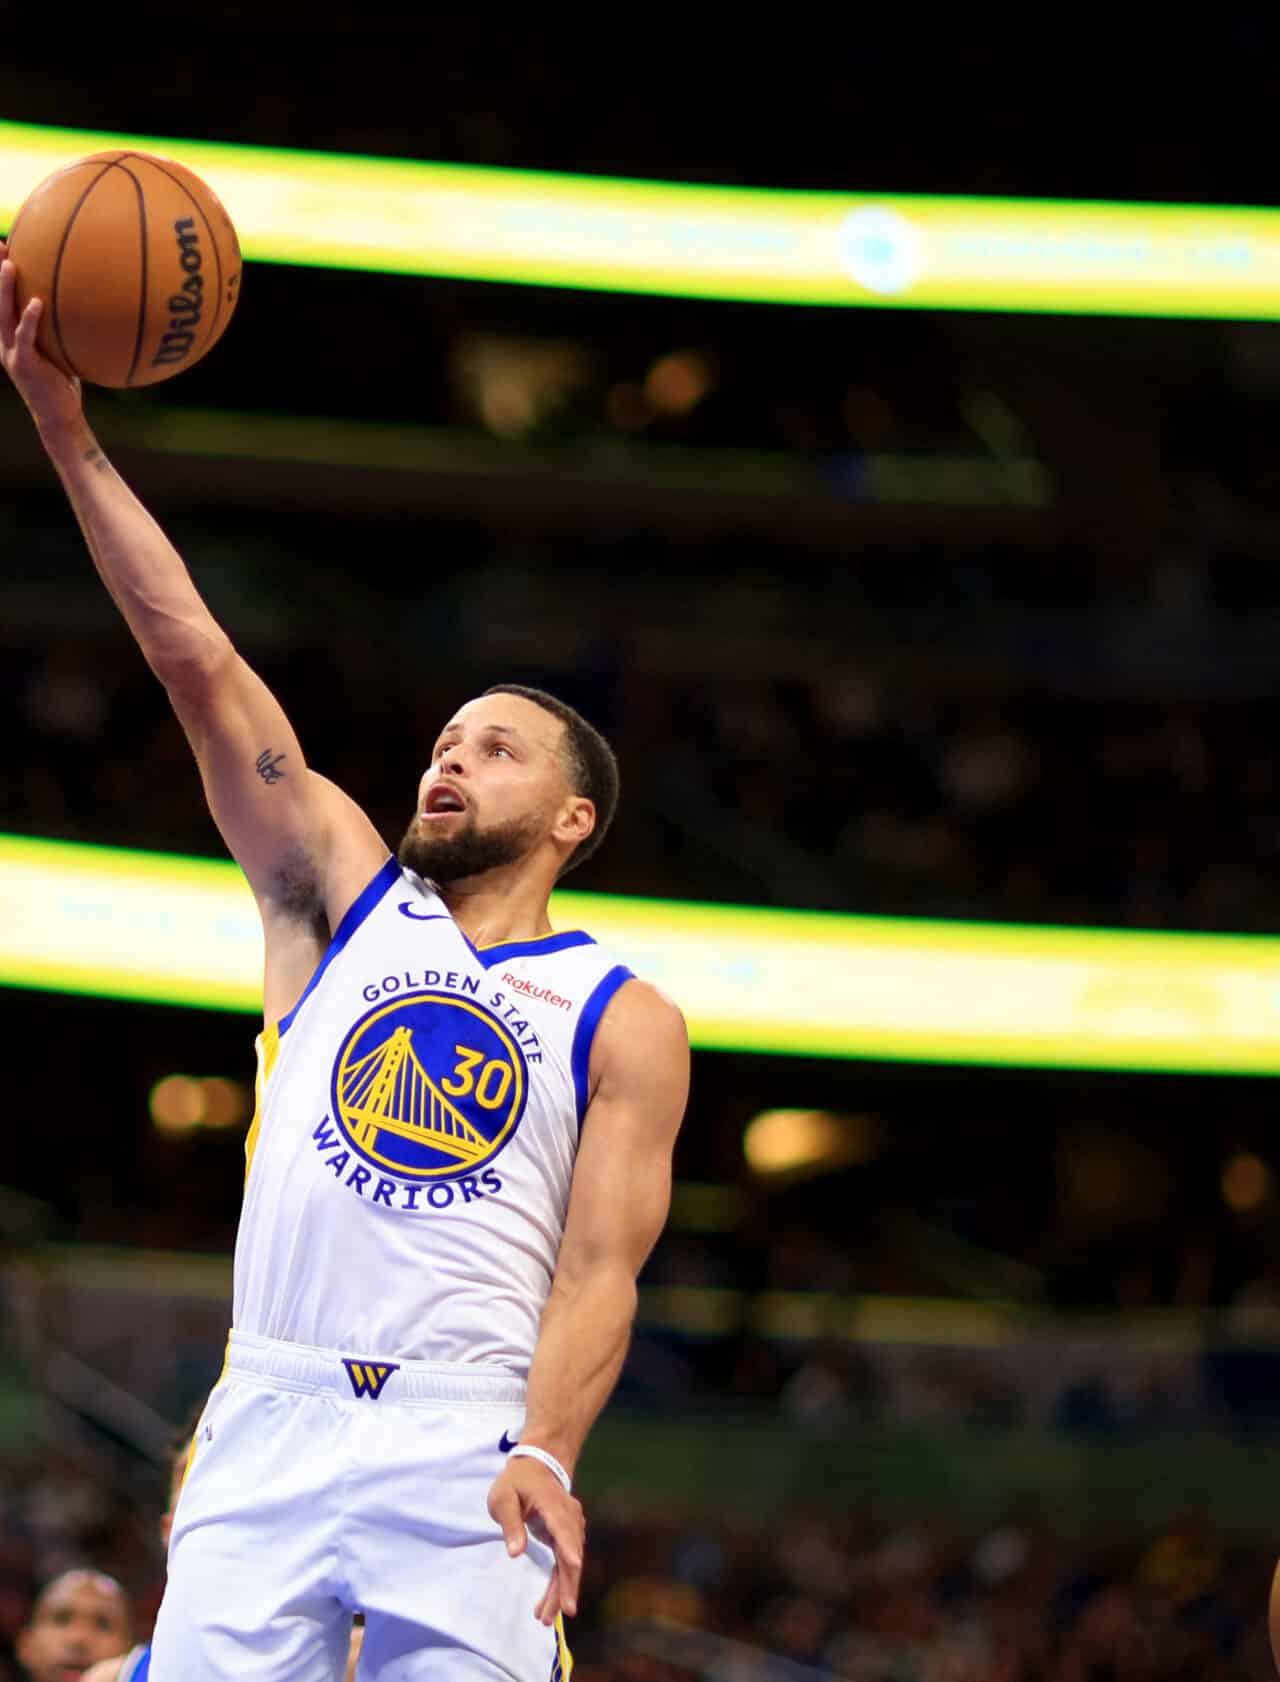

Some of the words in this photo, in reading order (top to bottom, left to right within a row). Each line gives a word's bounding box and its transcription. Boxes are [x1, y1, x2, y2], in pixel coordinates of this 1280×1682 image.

[154, 218, 203, 364] Wilson
[362, 970, 480, 1003] GOLDEN
[490, 992, 542, 1064] STATE
[501, 972, 572, 1012] Rakuten
[441, 1045, 513, 1109] 30
[312, 1114, 503, 1210] WARRIORS
